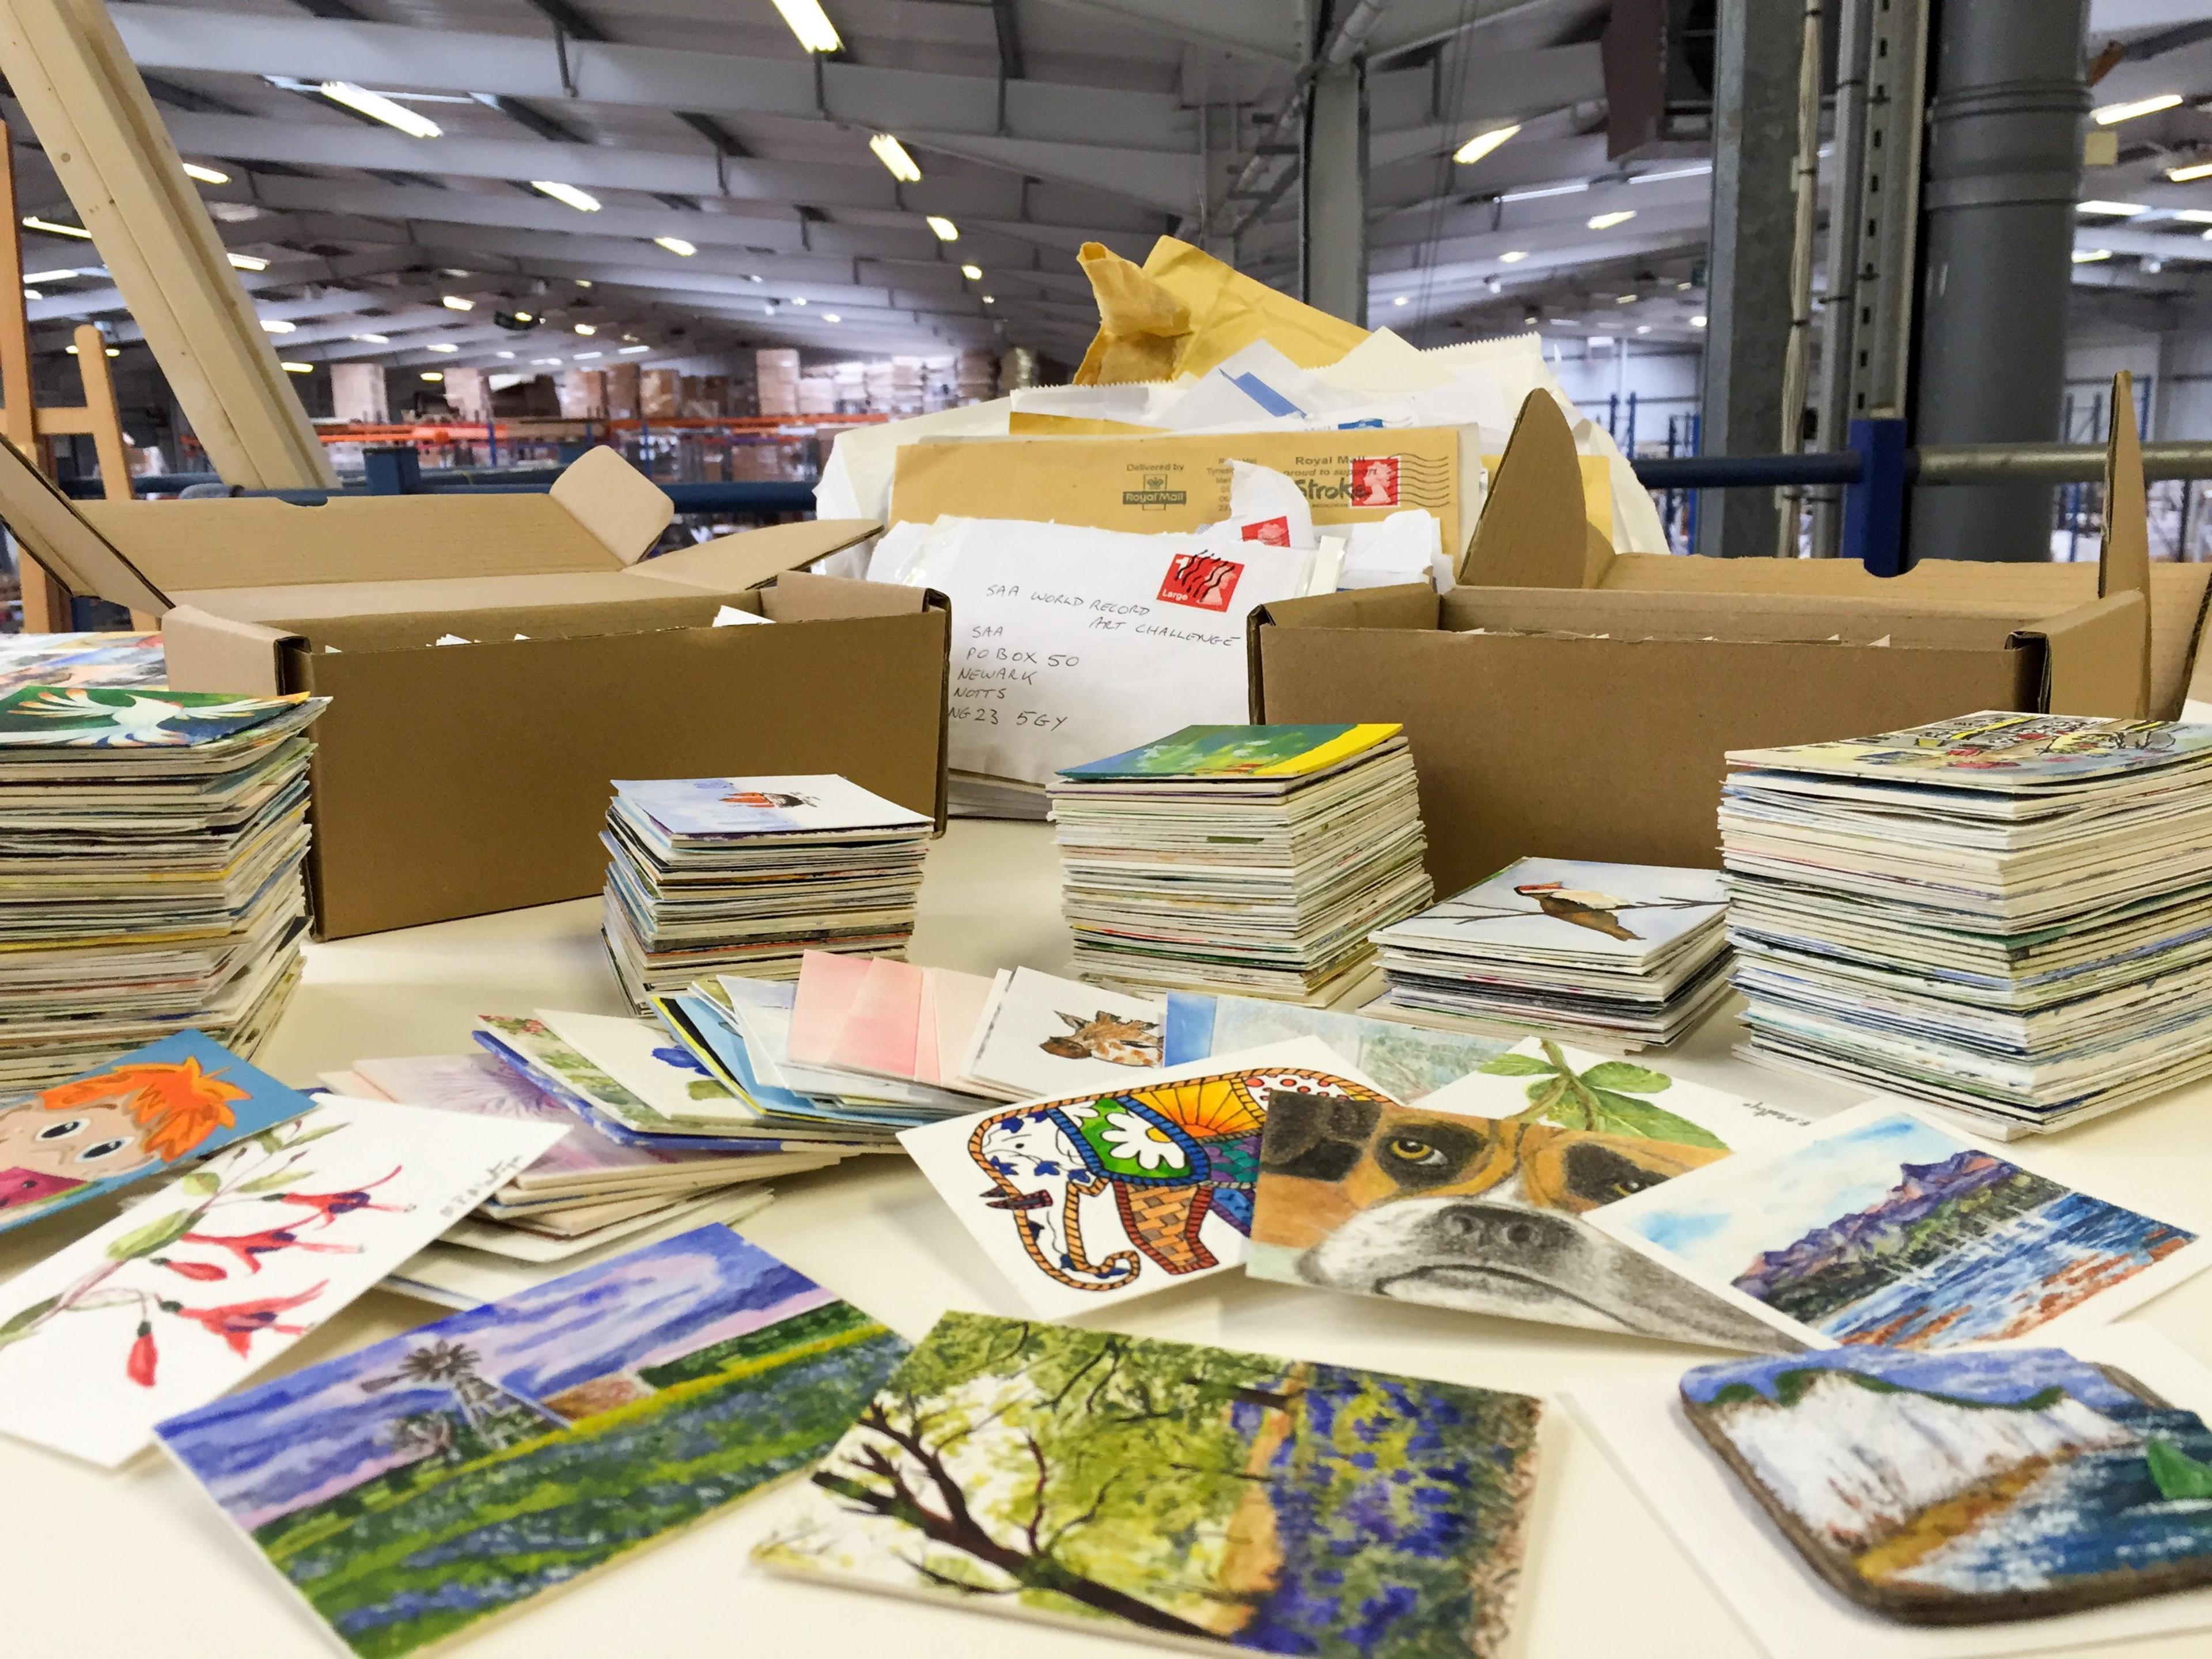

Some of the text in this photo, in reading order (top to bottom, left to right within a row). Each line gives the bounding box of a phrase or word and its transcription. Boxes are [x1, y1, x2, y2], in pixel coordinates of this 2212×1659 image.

[1126, 463, 1184, 472] Delivered by
[1295, 456, 1332, 466] Royal
[1126, 492, 1185, 503] Royal Mail
[986, 585, 1150, 616] SAA WORLD RECORD
[1162, 588, 1188, 601] Large
[972, 626, 1003, 638] SAA
[1089, 616, 1241, 646] ART CHALLENGE
[966, 647, 1080, 667] PO BOX 50
[957, 667, 1037, 685] NEWARK
[953, 687, 1007, 699] NOTTS
[1016, 711, 1068, 732] 5GY
